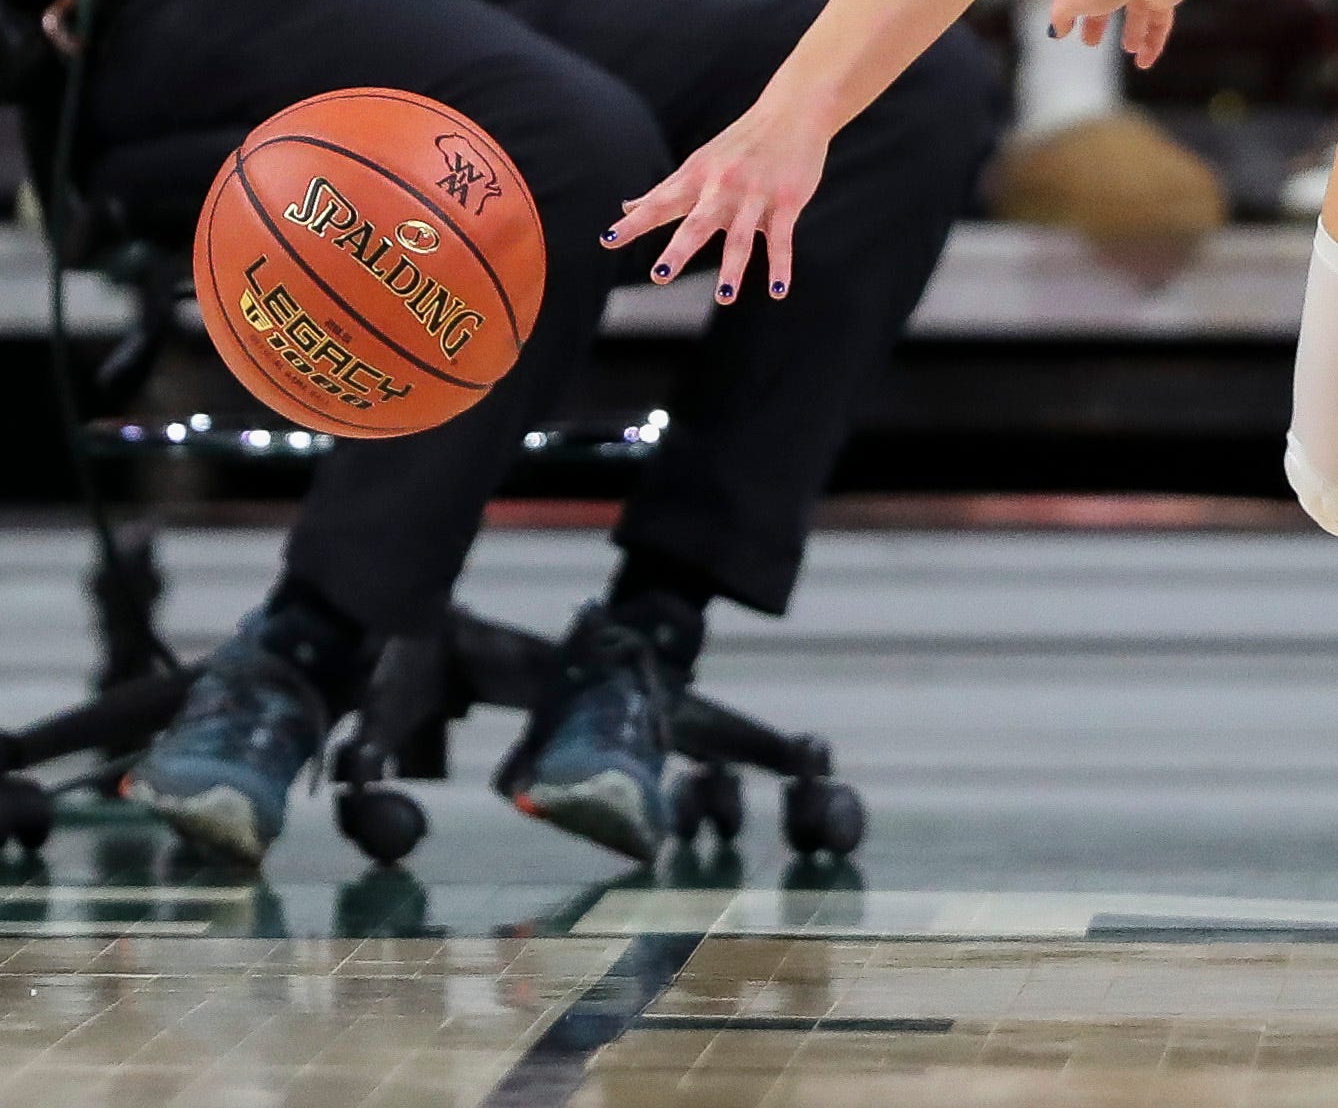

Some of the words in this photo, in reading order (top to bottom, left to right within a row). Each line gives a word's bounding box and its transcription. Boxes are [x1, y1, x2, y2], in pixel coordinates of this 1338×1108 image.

[243, 254, 414, 403] LEGACY
[283, 177, 485, 360] SPALDING
[266, 331, 374, 410] 1000
